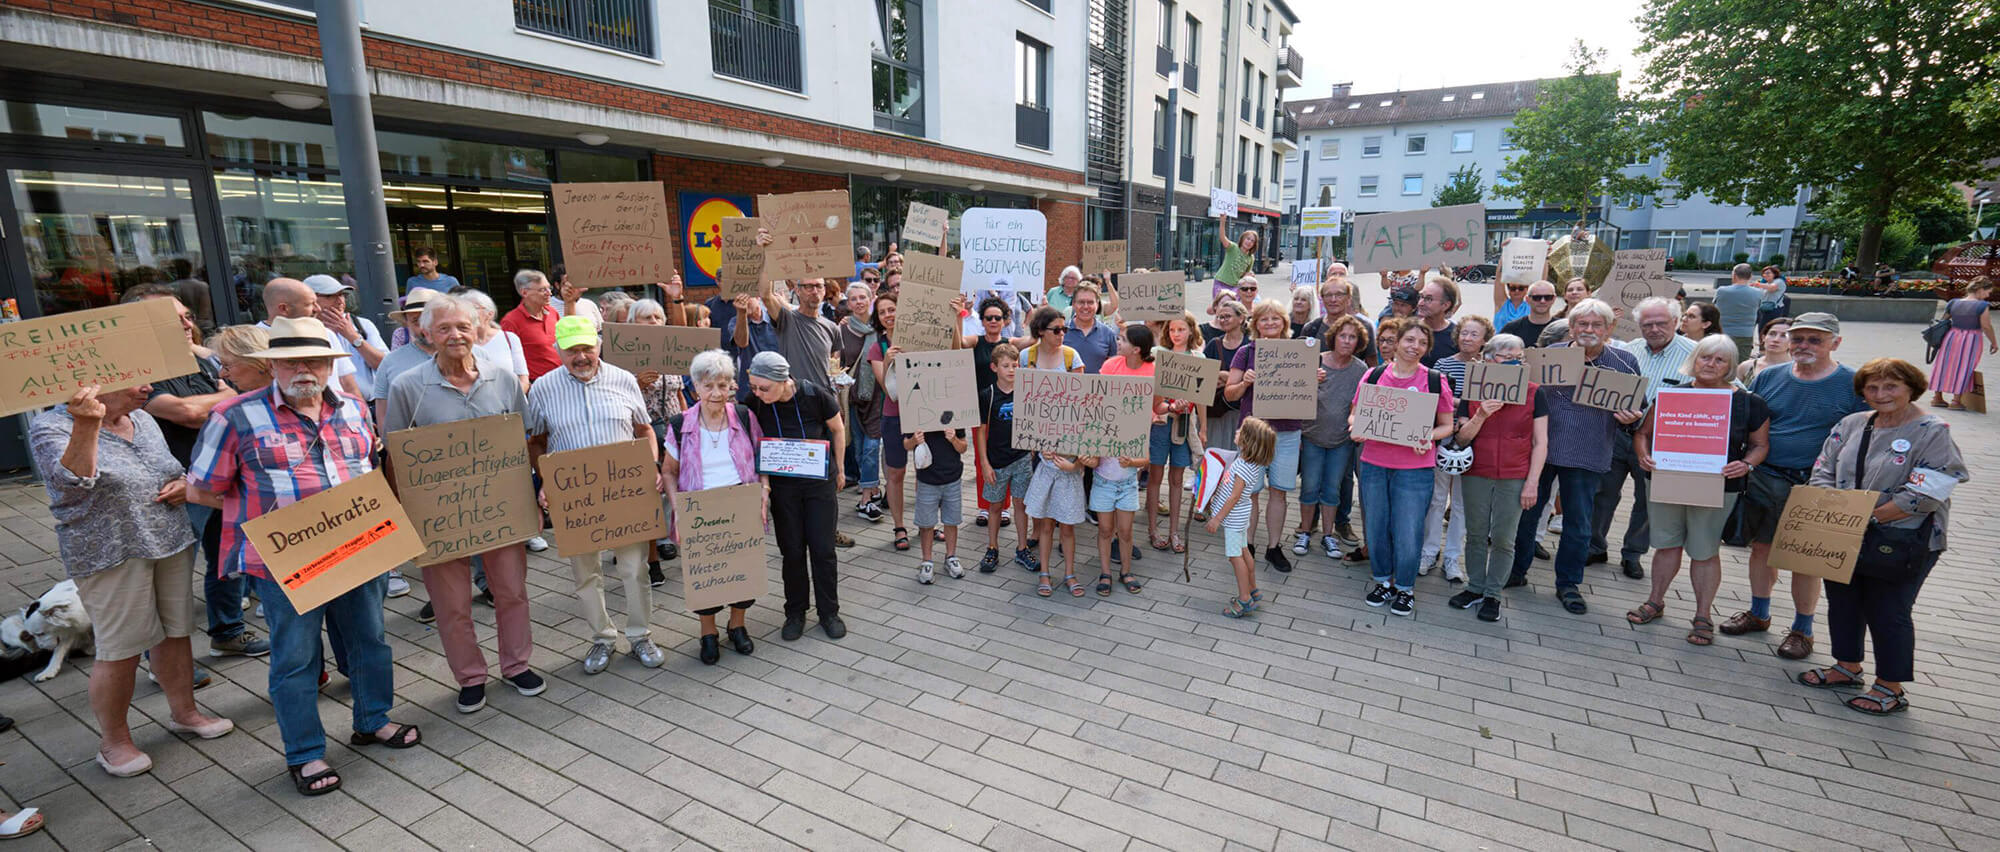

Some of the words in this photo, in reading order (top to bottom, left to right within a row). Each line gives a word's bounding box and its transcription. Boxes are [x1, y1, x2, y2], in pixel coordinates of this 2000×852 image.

[1007, 218, 1023, 231] ein
[571, 239, 597, 253] Kein
[600, 239, 655, 255] Mensch
[962, 237, 1045, 253] VIELSEITIGES
[909, 263, 945, 285] Vielfalt
[969, 257, 1042, 278] BOTNANG
[0, 316, 125, 347] REIHEIT
[609, 328, 652, 353] Kein
[2, 337, 104, 361] FREIHEIT
[44, 346, 101, 366] FÜR
[635, 356, 651, 368] ist
[1160, 353, 1178, 370] Wir
[1179, 364, 1203, 374] sind
[20, 368, 87, 394] ALLE
[1022, 373, 1082, 393] HAND
[1090, 379, 1109, 396] IN
[1110, 380, 1153, 396] HAND
[1272, 378, 1290, 388] sind
[1292, 378, 1309, 388] alle
[1467, 363, 1524, 403] Hand
[1541, 353, 1567, 385] in
[1575, 367, 1642, 412] Hand
[1023, 403, 1036, 417] IN
[1039, 402, 1117, 423] BOTNANG
[1659, 411, 1677, 419] Jedes
[1711, 413, 1726, 421] egal
[1015, 417, 1035, 433] FÜR
[1362, 420, 1403, 441] ALLE
[402, 429, 494, 467] Soziale
[408, 447, 528, 491] Ungerechtigkeit
[553, 463, 599, 493] Gib
[606, 459, 645, 483] Hass
[437, 476, 491, 507] nährt
[562, 491, 595, 513] und
[602, 486, 648, 505] Hetze
[684, 496, 703, 513] In
[267, 495, 382, 555] Demokratie
[422, 500, 508, 537] rechtes
[565, 512, 608, 531] keine
[1783, 519, 1808, 532] GE
[427, 525, 516, 561] Denken
[688, 548, 701, 561] im
[703, 536, 765, 557] Stuttgarter
[688, 561, 729, 577] Westen
[691, 572, 747, 592] zuhause
